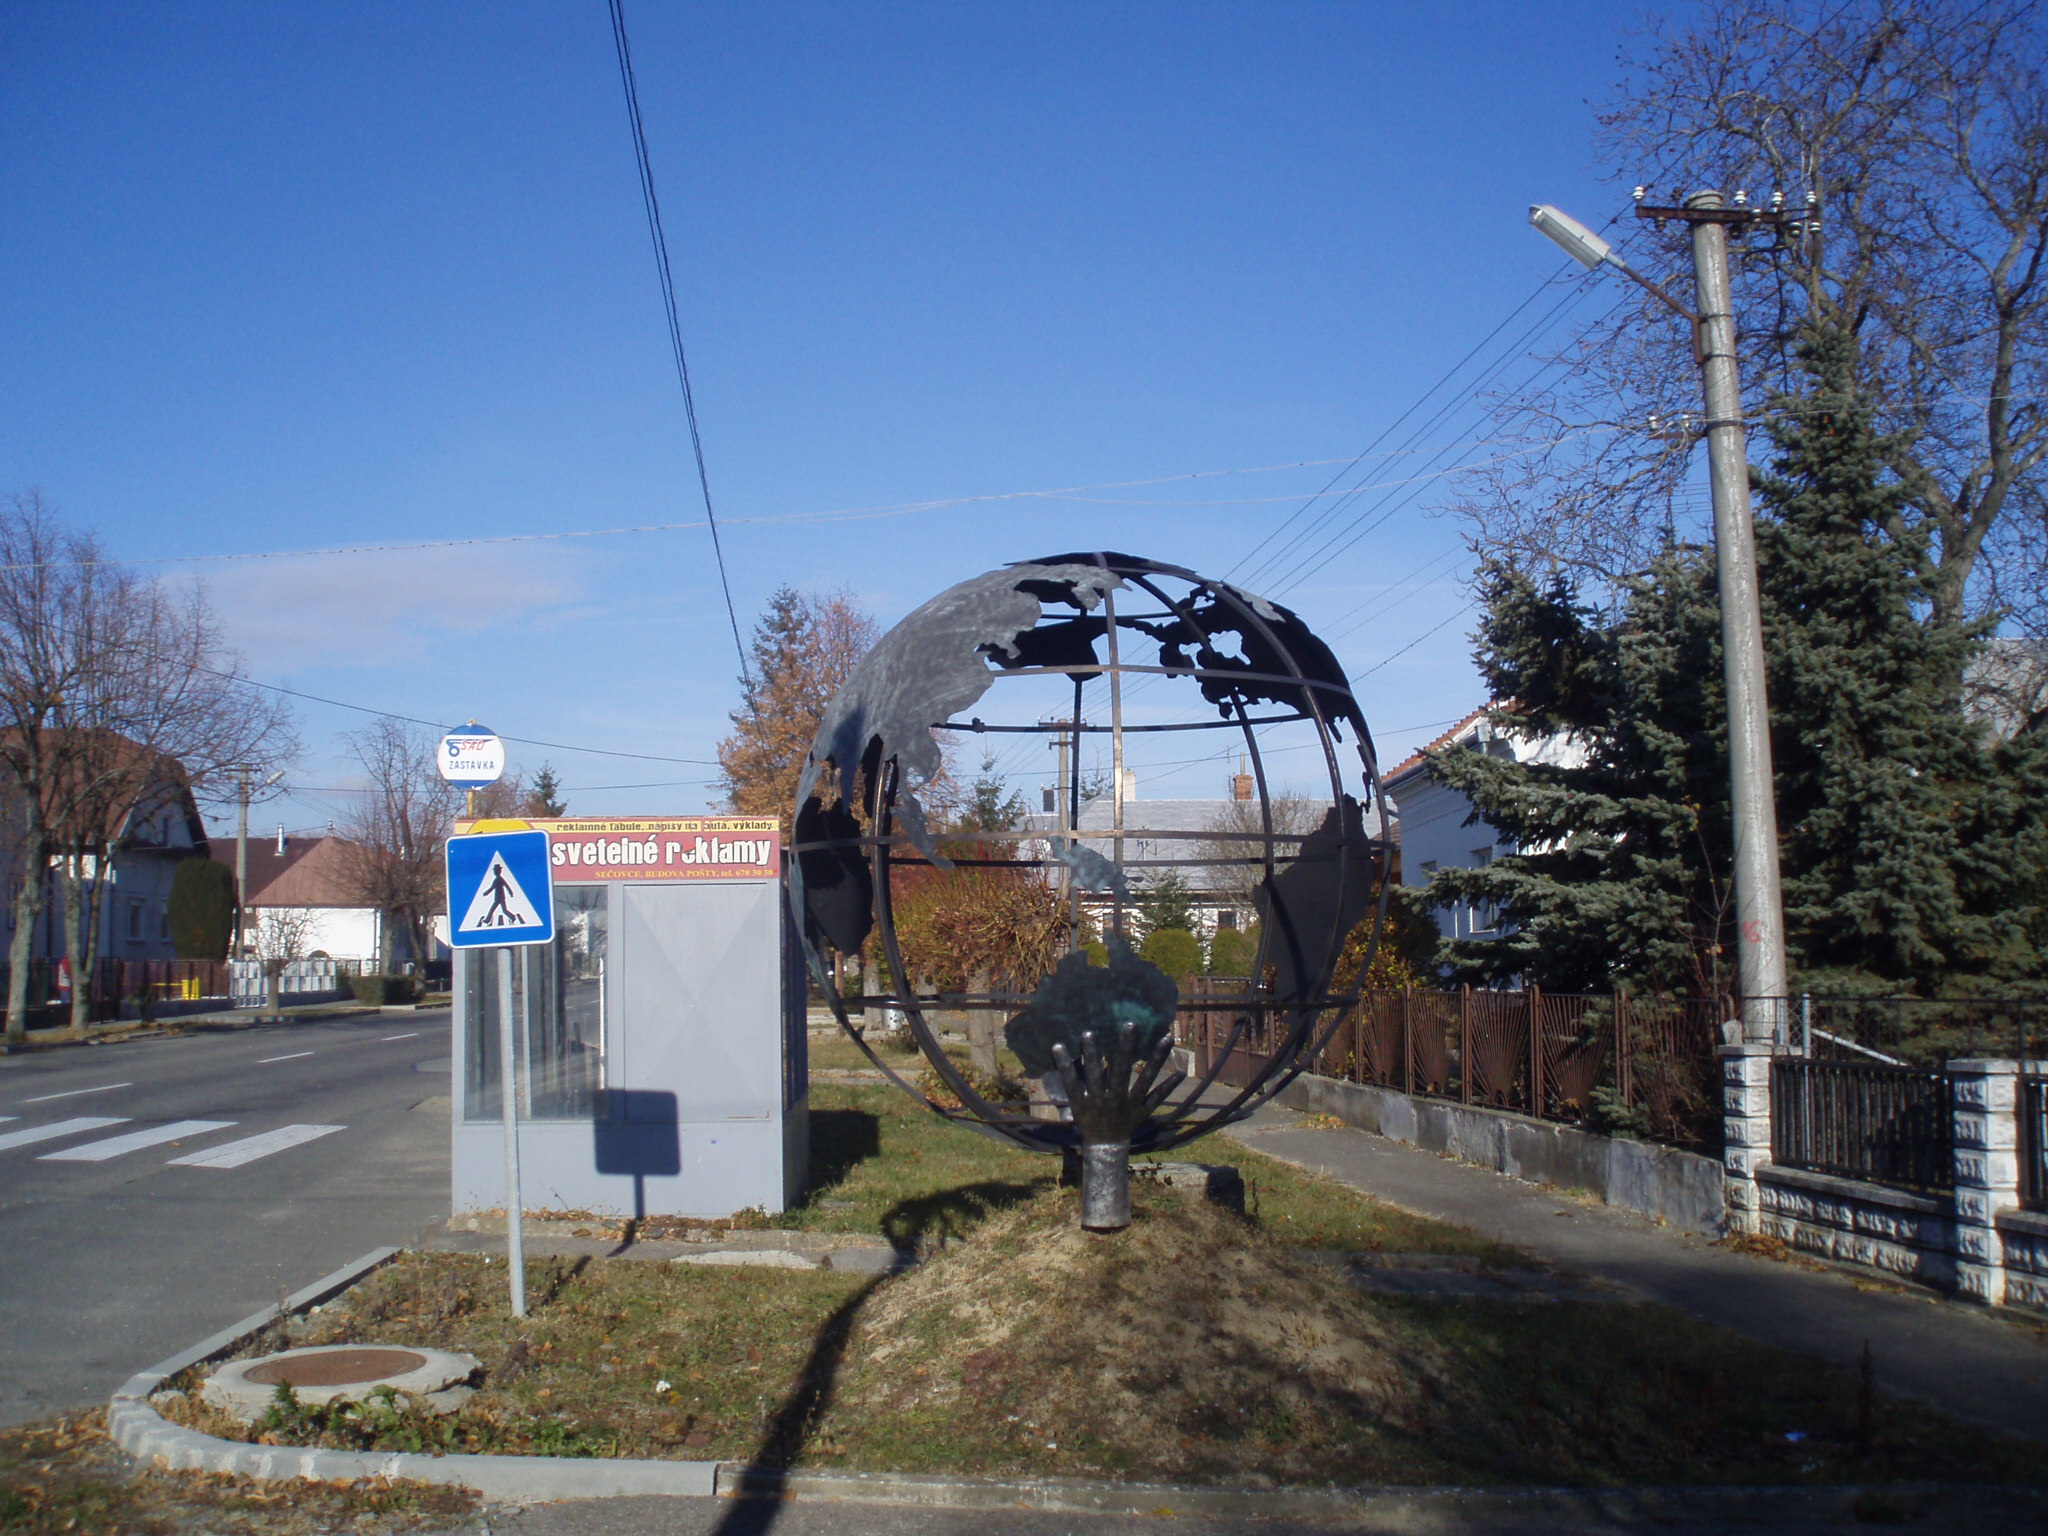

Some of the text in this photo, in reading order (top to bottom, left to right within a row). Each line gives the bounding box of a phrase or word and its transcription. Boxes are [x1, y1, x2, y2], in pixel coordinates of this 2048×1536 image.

[685, 822, 698, 830] na
[733, 820, 773, 830] výklady
[552, 834, 659, 866] svetelné
[645, 869, 684, 878] BUDOVA
[721, 869, 733, 877] tel.
[735, 869, 751, 877] 678
